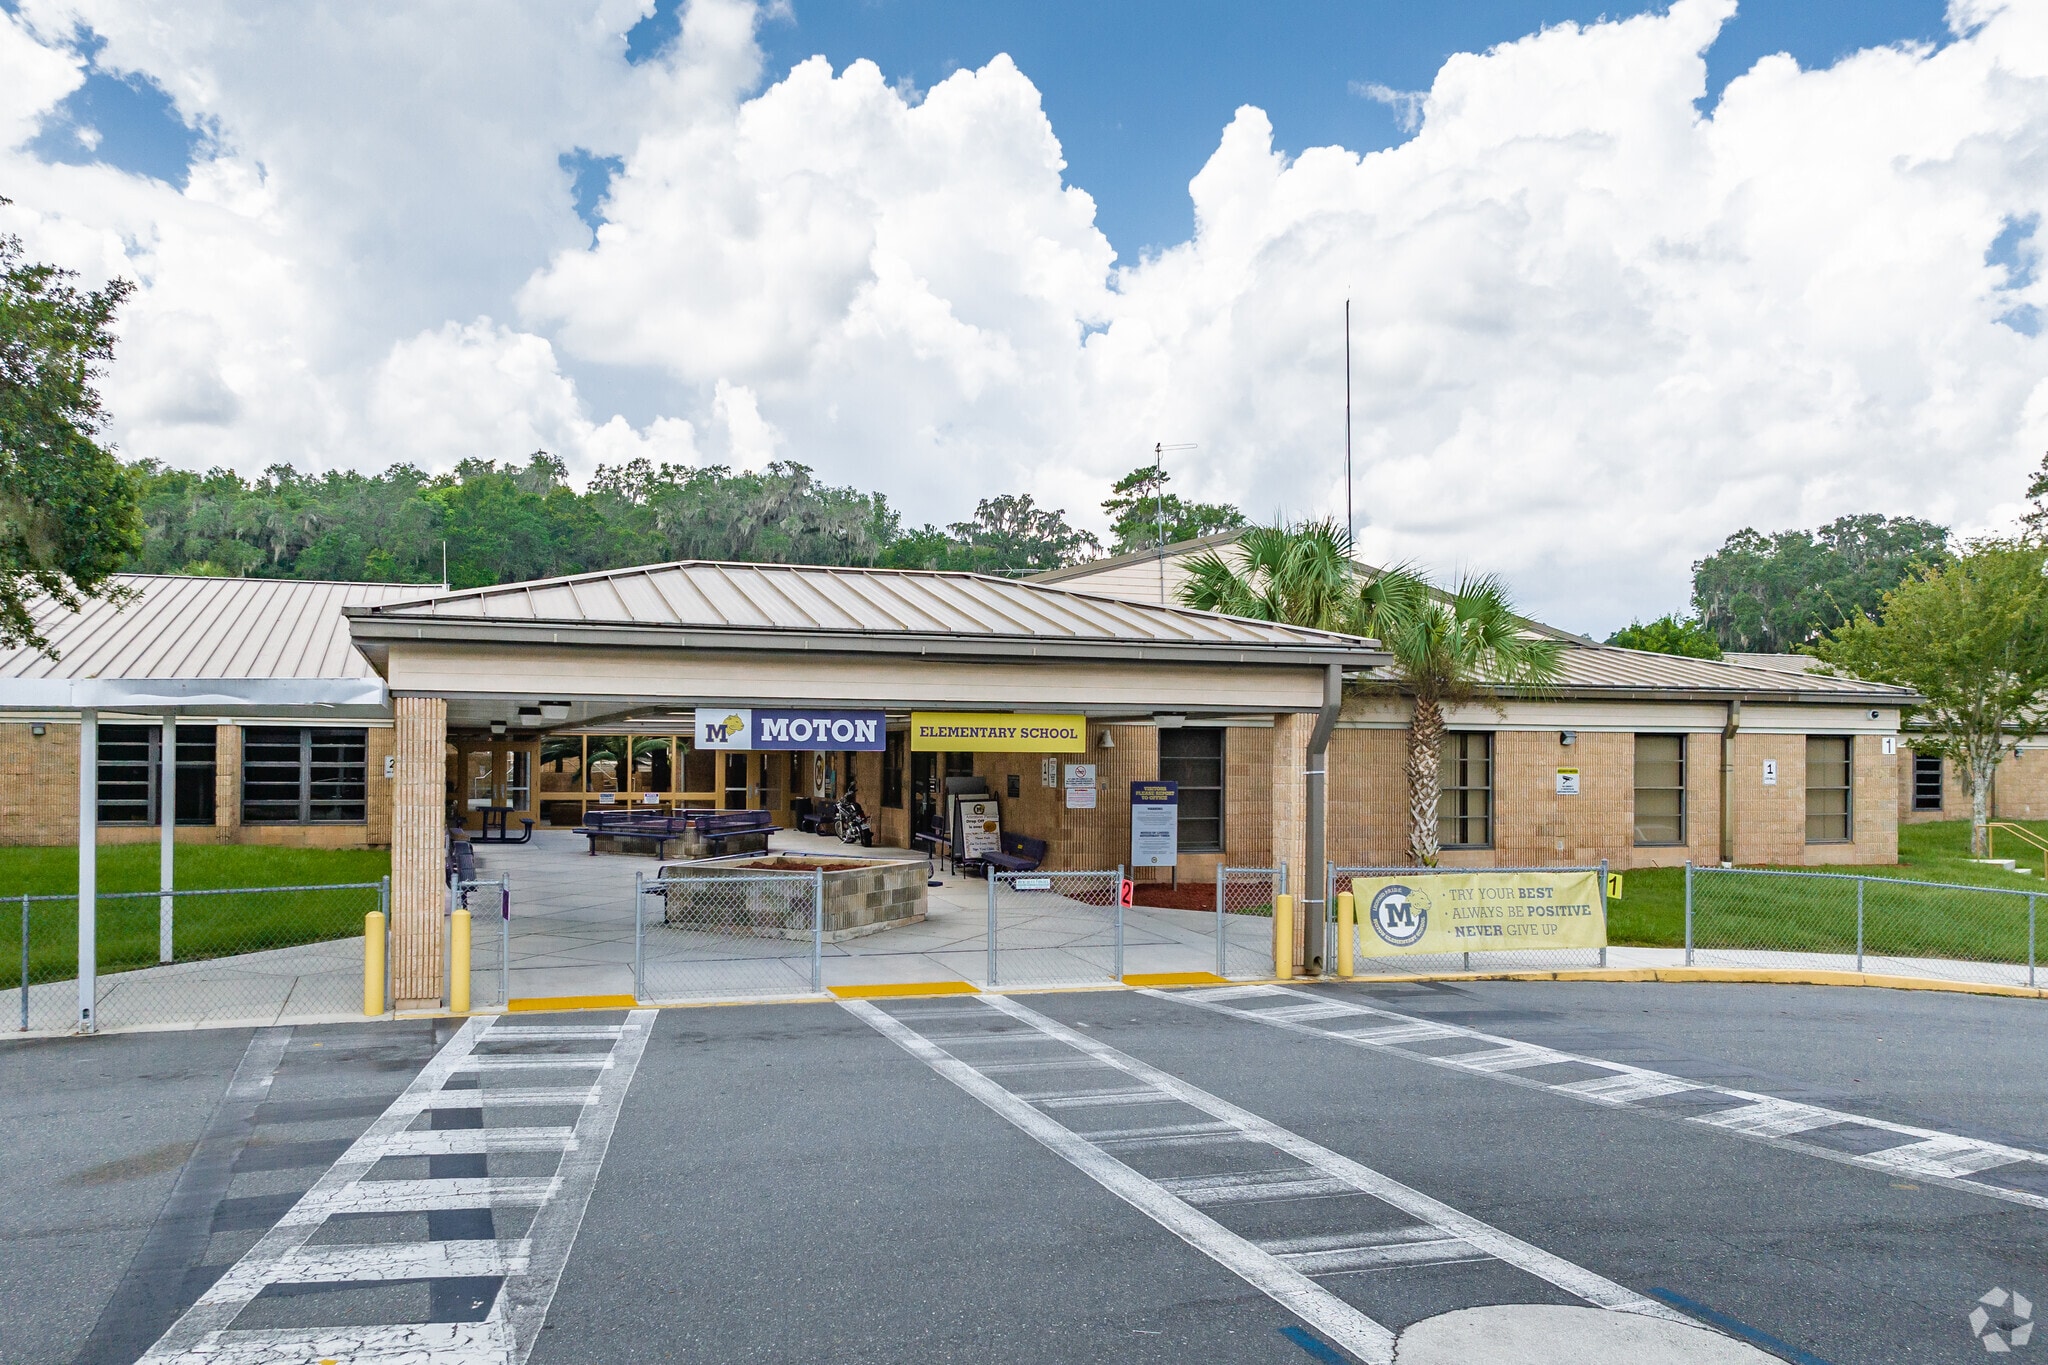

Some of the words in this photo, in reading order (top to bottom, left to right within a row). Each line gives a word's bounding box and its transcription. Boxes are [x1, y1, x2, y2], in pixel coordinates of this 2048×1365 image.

[705, 724, 728, 743] M
[761, 718, 877, 743] MOTON
[919, 726, 1016, 739] ELEMENTARY
[1020, 728, 1078, 739] SCHOOL
[1886, 738, 1891, 753] 1
[1767, 764, 1773, 774] 1
[1122, 882, 1131, 905] 2
[1449, 888, 1474, 900] TRY
[1478, 887, 1515, 899] YOUR
[1518, 887, 1553, 899] BEST
[1609, 876, 1616, 896] 1
[1385, 903, 1415, 927] M
[1452, 906, 1504, 919] ALWAYS
[1508, 905, 1524, 918] BE
[1527, 904, 1591, 917] POSITIVE
[1455, 925, 1503, 938] NEVER
[1507, 924, 1539, 936] GIVE
[1542, 923, 1558, 936] UP
